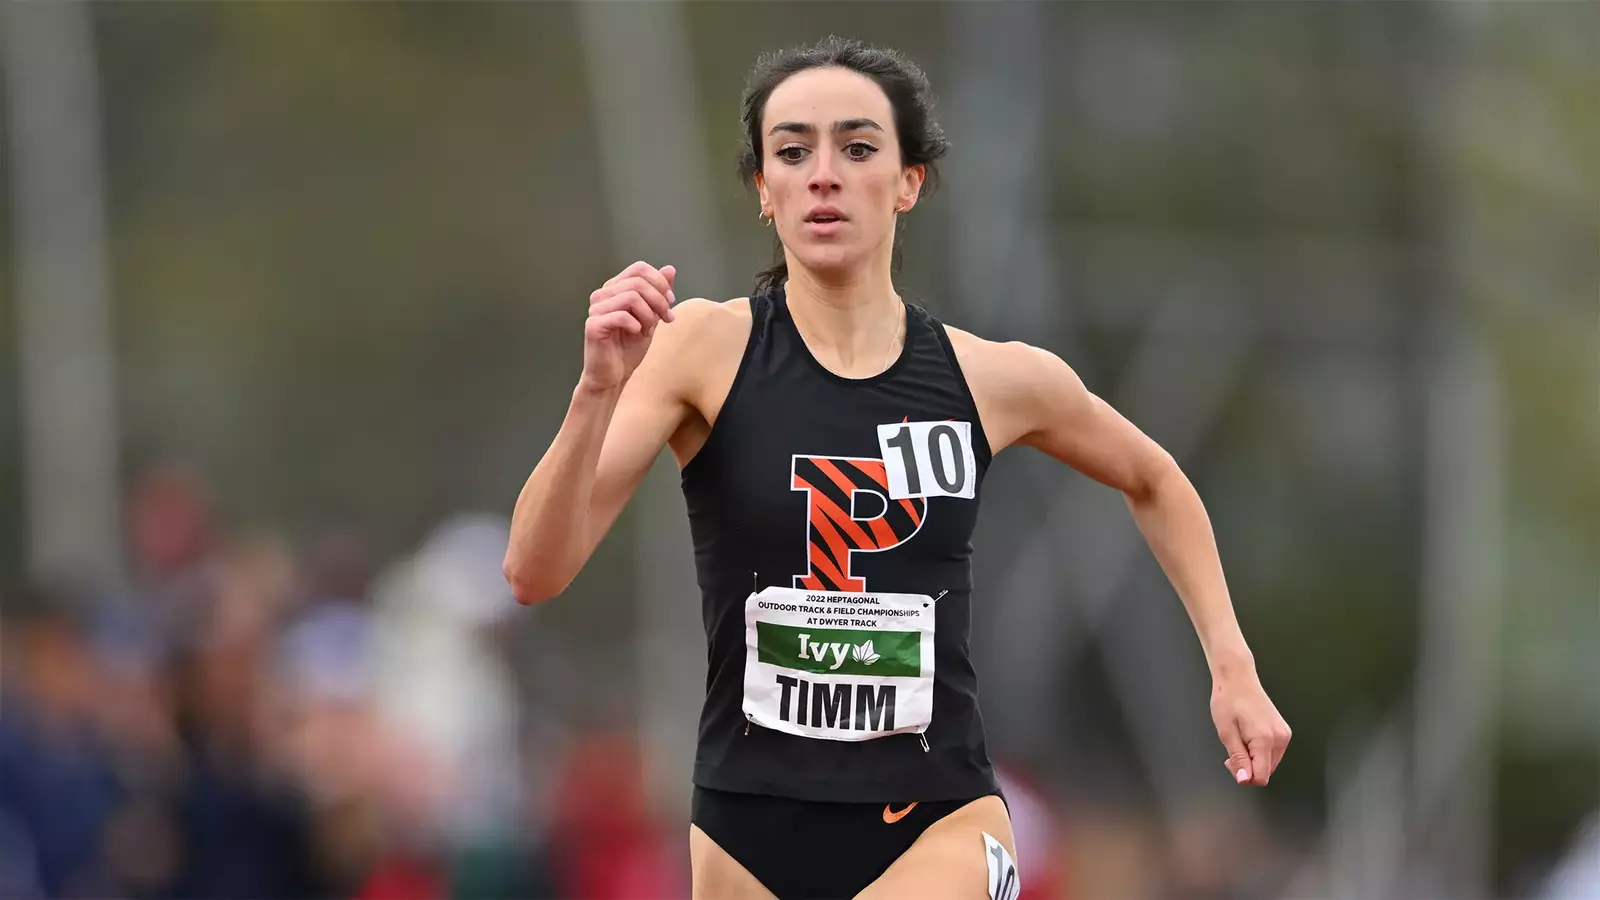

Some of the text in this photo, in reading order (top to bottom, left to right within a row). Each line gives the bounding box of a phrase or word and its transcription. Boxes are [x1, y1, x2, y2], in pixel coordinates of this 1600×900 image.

[886, 424, 966, 495] 10
[790, 454, 928, 593] P
[758, 601, 797, 612] OUTDOOR
[798, 605, 825, 614] TRACK
[833, 607, 856, 615] FIELD
[857, 608, 920, 617] CHAMPIONSHIPS
[806, 594, 880, 605] 2022 HEPTAGONAL
[806, 617, 877, 627] AT DWYER TRACK
[797, 633, 851, 670] Ivy
[776, 674, 897, 731] TIMM
